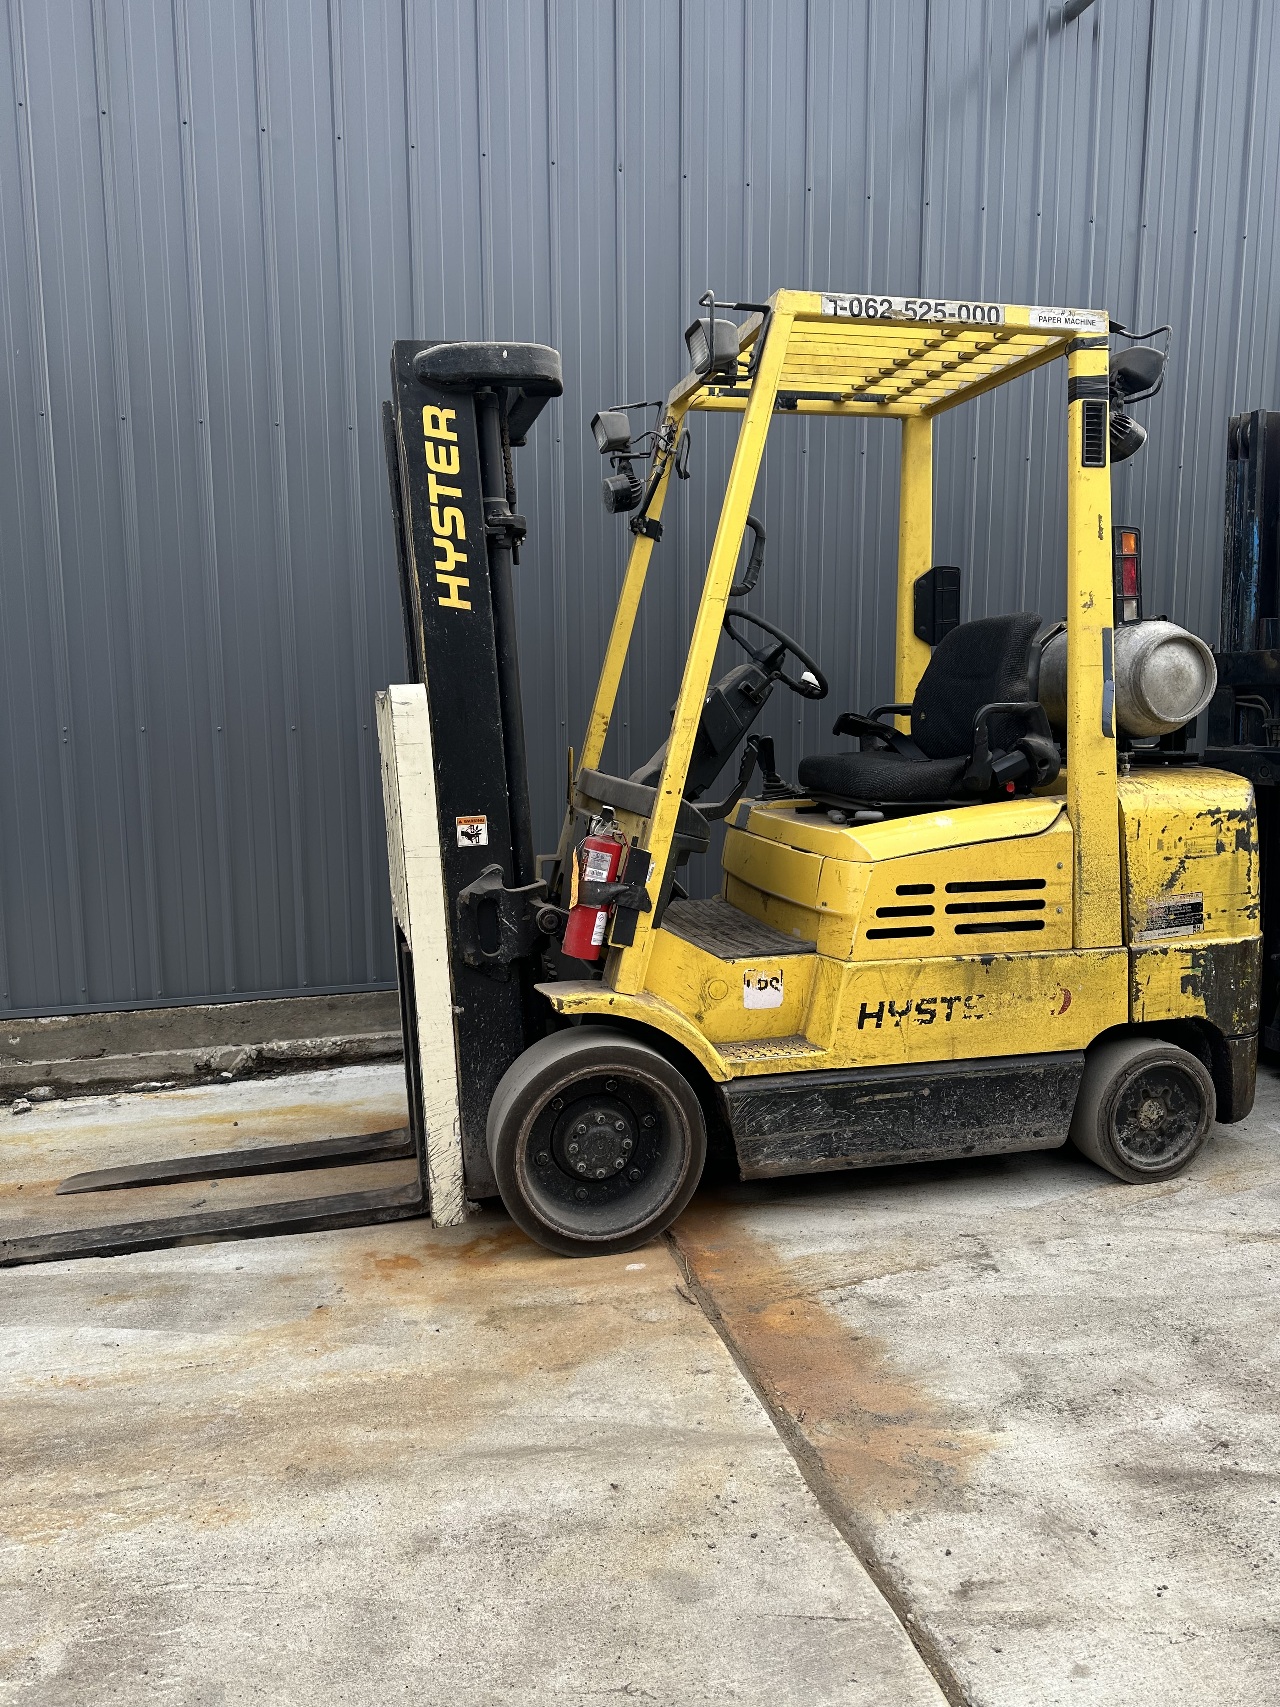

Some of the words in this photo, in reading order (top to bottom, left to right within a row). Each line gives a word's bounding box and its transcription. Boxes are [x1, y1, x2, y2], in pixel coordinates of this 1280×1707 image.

[1038, 315, 1062, 324] PAPER
[1064, 317, 1097, 326] MACHINE
[422, 405, 472, 610] HYSTER
